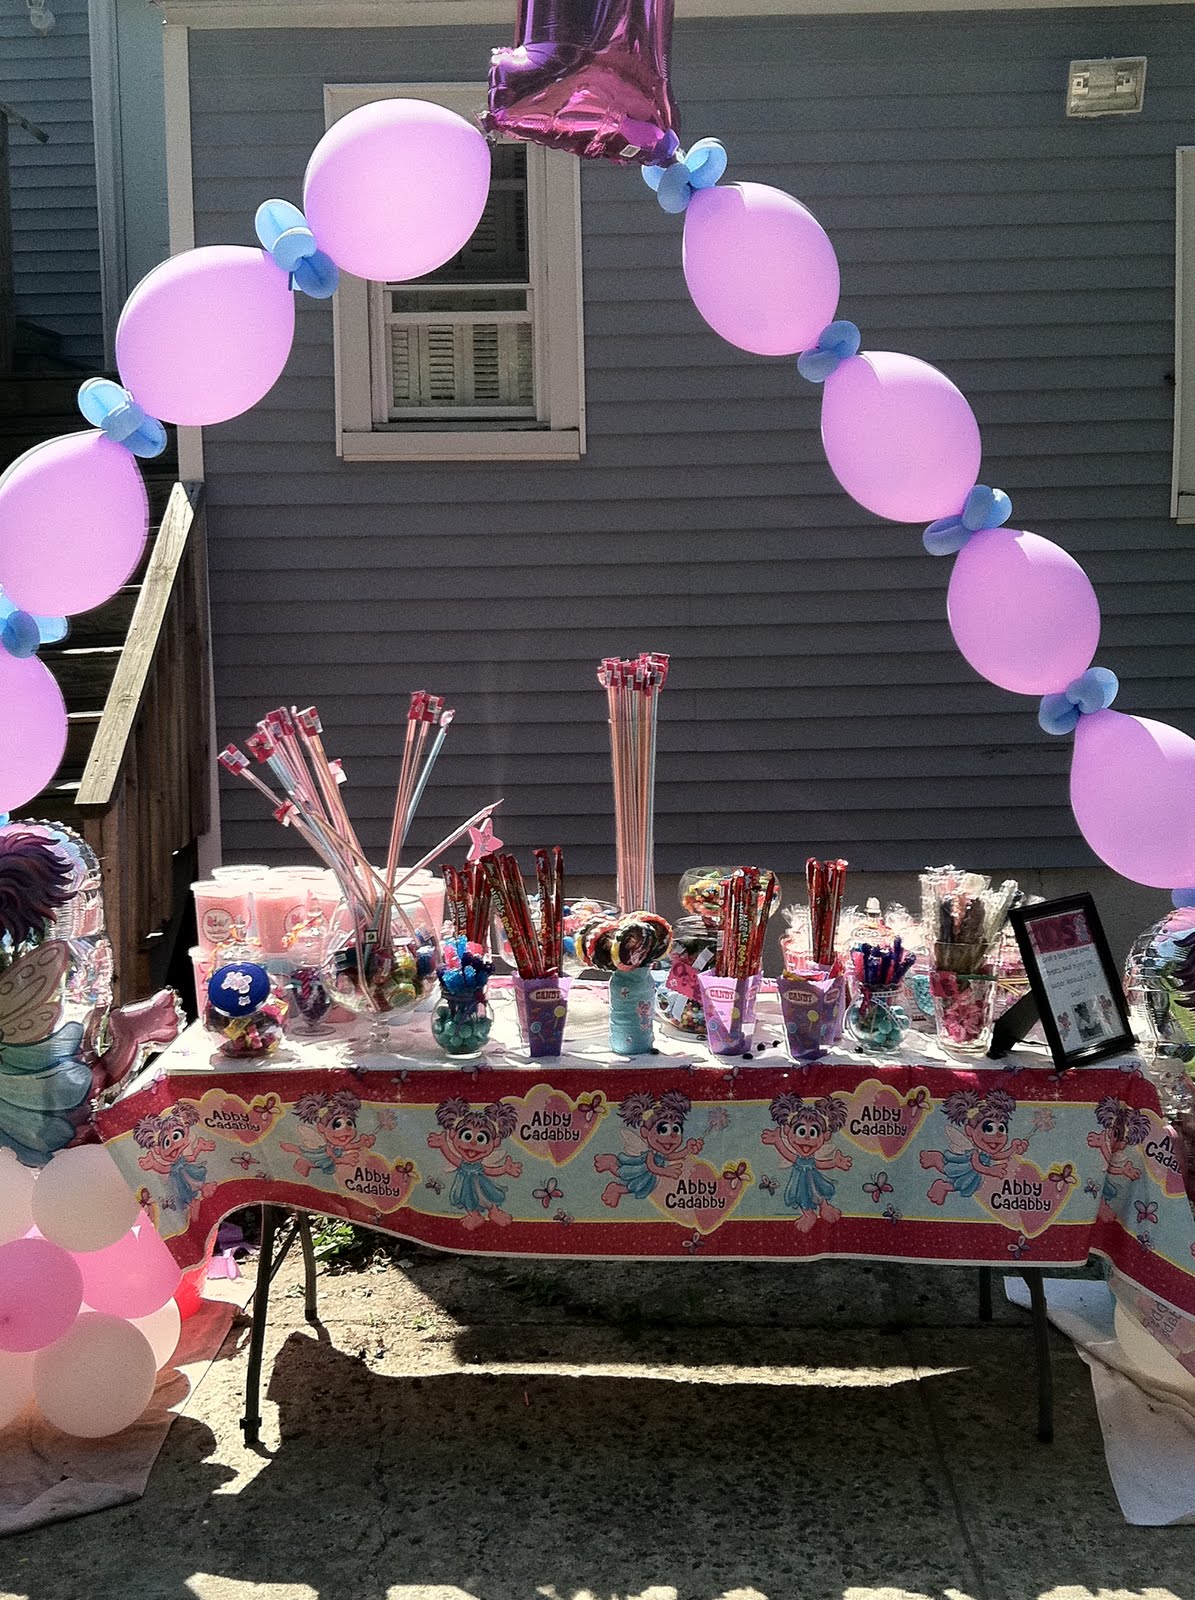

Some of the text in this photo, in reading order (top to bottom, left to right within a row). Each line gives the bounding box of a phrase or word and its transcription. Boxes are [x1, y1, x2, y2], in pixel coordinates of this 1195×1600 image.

[535, 990, 561, 1000] CANDY
[710, 989, 735, 1000] CANDY
[788, 991, 813, 1003] CANDY
[212, 1110, 249, 1121] Abby
[531, 1111, 572, 1127] Abby
[861, 1105, 901, 1122] Abby
[204, 1118, 260, 1131] Cadabby
[520, 1124, 580, 1141] Cadabby
[850, 1119, 907, 1136] Cadabby
[354, 1167, 390, 1184] Abby
[345, 1179, 400, 1197] Cadabby
[676, 1179, 717, 1195] Abby
[1001, 1179, 1042, 1196] Abby
[665, 1192, 725, 1209] Cadabby
[991, 1192, 1051, 1211] Cadabby
